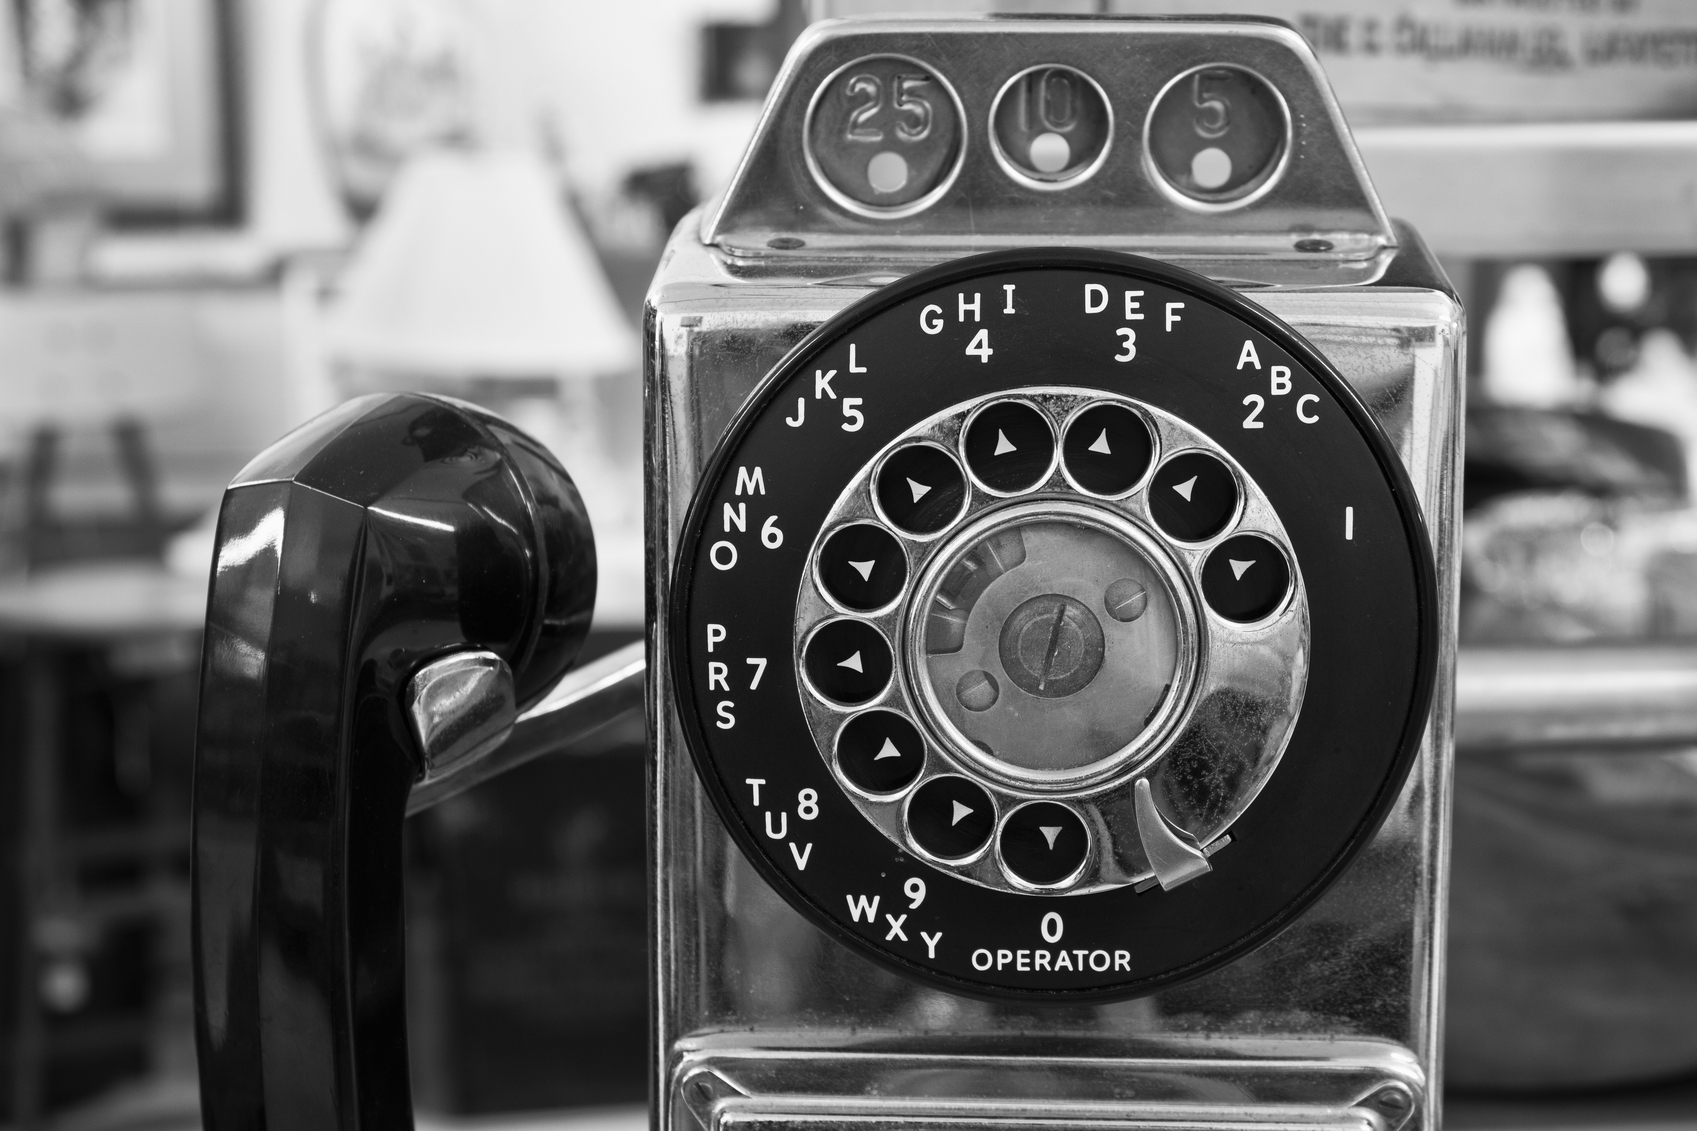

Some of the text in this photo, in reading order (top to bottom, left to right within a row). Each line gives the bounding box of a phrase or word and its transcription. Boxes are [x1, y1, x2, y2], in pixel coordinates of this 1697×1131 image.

[845, 73, 933, 142] 25
[1017, 66, 1079, 134] 10
[1192, 68, 1235, 139] 5
[919, 283, 1016, 335] G H I
[1084, 283, 1186, 333] D E F
[965, 328, 994, 364] 4
[1114, 326, 1137, 363] 3
[785, 342, 868, 428] J K L
[1236, 339, 1321, 425] A B C
[840, 397, 865, 433] 5
[1242, 393, 1265, 429] 2
[734, 465, 766, 496] M
[723, 502, 747, 533] N
[760, 514, 784, 550] 6
[706, 623, 736, 730] P R S
[745, 657, 768, 691] 7
[797, 787, 820, 821] 8
[745, 777, 813, 871] T U V
[903, 877, 927, 910] 9
[845, 894, 943, 959] W X Y
[1040, 911, 1064, 944] 0
[971, 948, 1131, 972] OPERATOR
